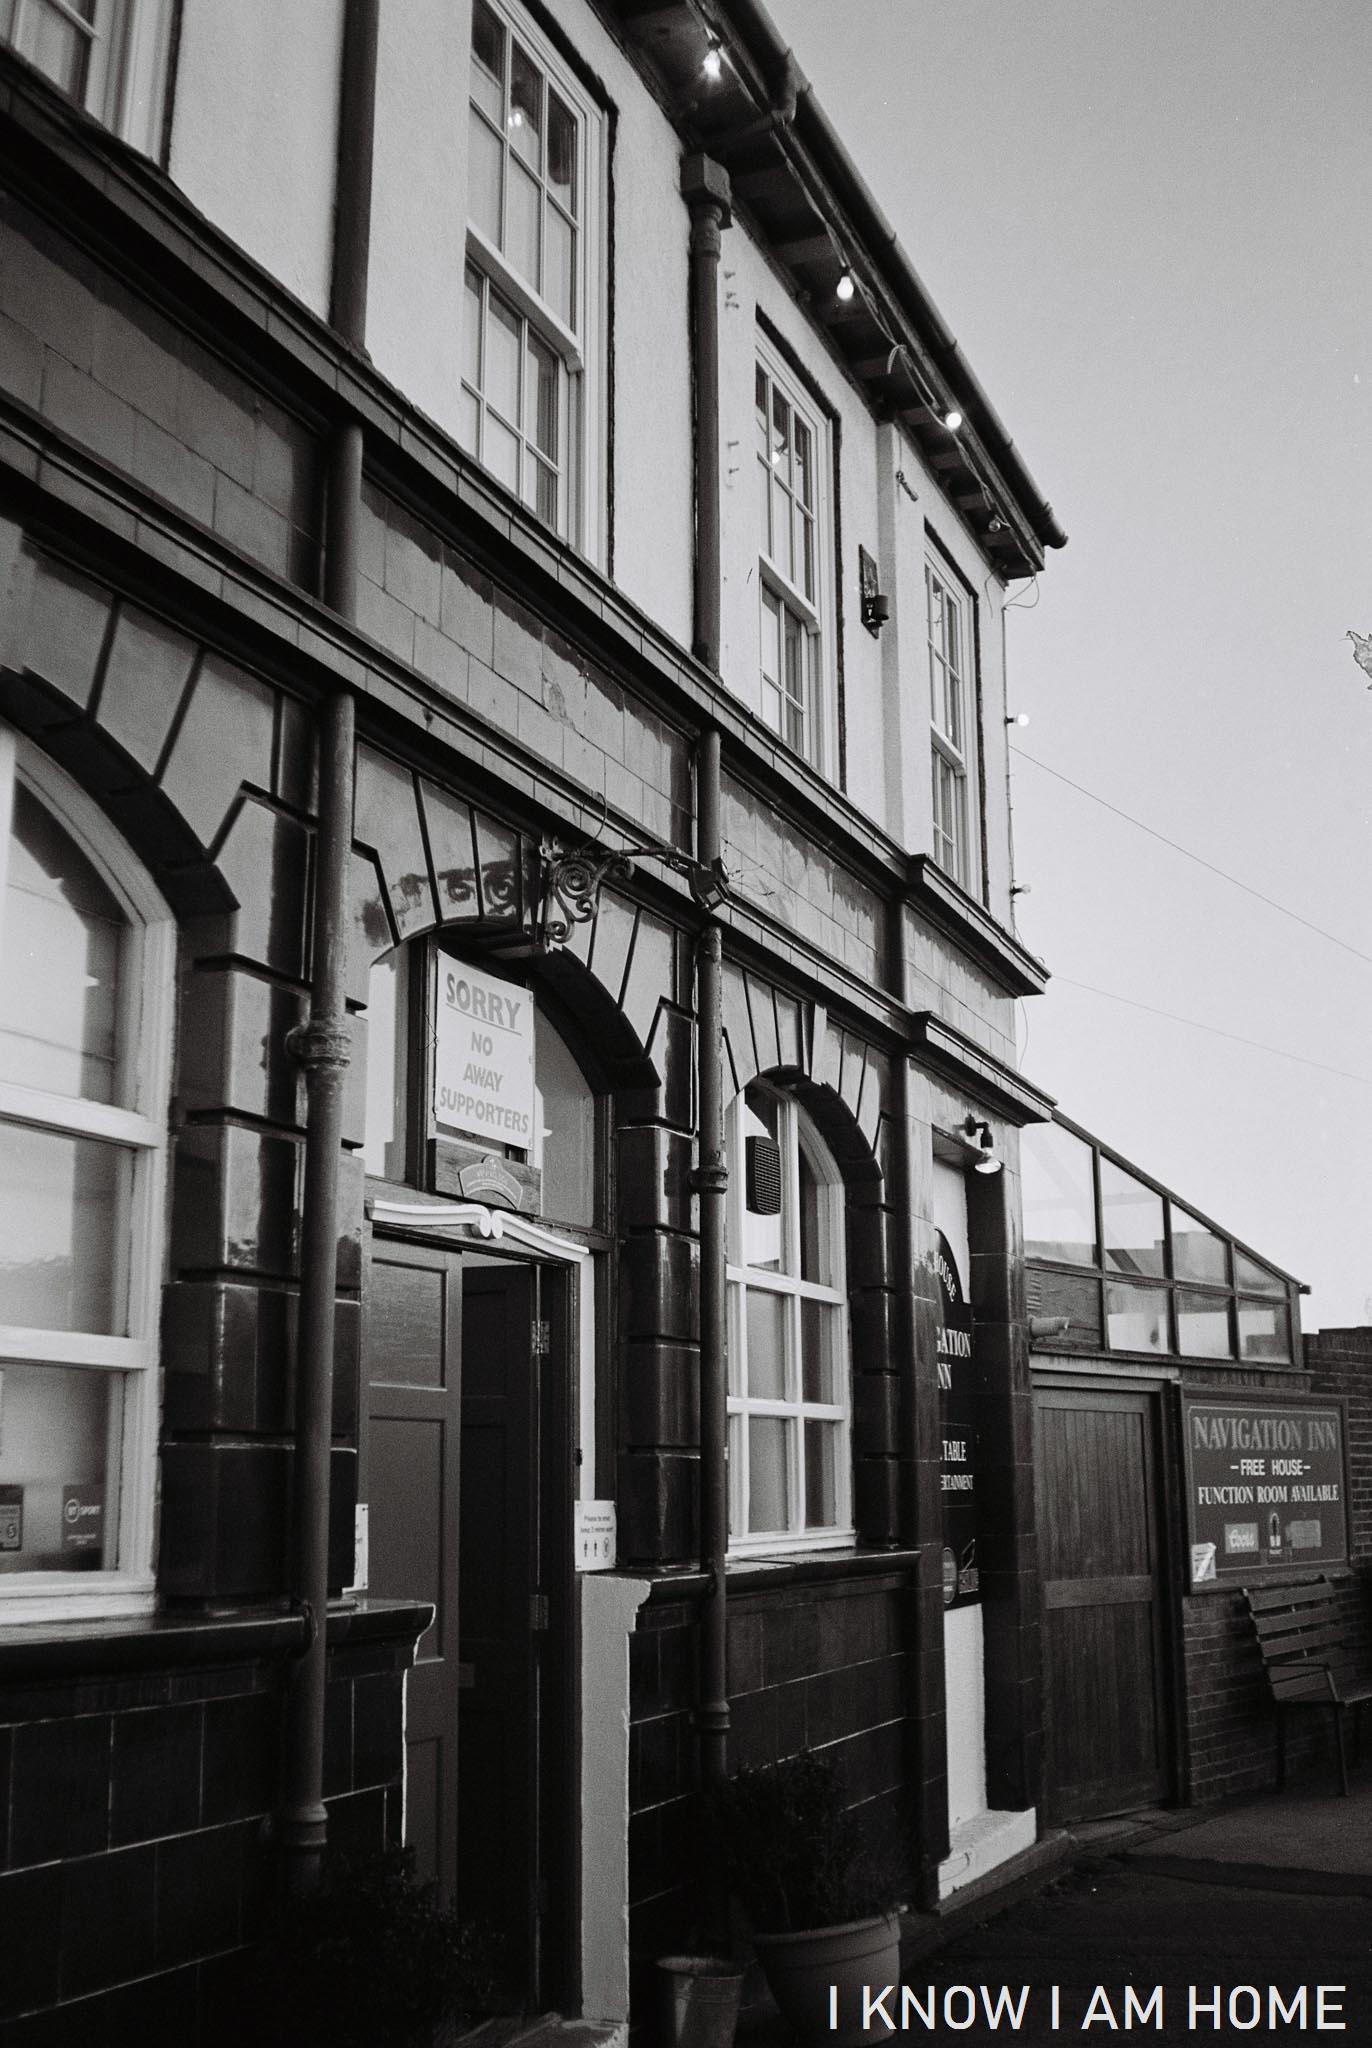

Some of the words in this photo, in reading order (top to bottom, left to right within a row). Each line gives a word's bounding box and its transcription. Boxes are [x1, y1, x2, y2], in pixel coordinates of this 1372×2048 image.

[446, 973, 521, 1029] SORRY
[471, 1031, 493, 1056] NO
[463, 1063, 504, 1093] AWAY
[439, 1086, 529, 1134] SUPPORTERS
[1192, 1416, 1301, 1450] NAVIGATION
[1307, 1421, 1337, 1451] INN
[942, 1440, 967, 1462] TABLE
[1198, 1486, 1254, 1505] FUNCTION
[1257, 1486, 1289, 1504] ROOM
[1290, 1484, 1340, 1502] AVAILABLE
